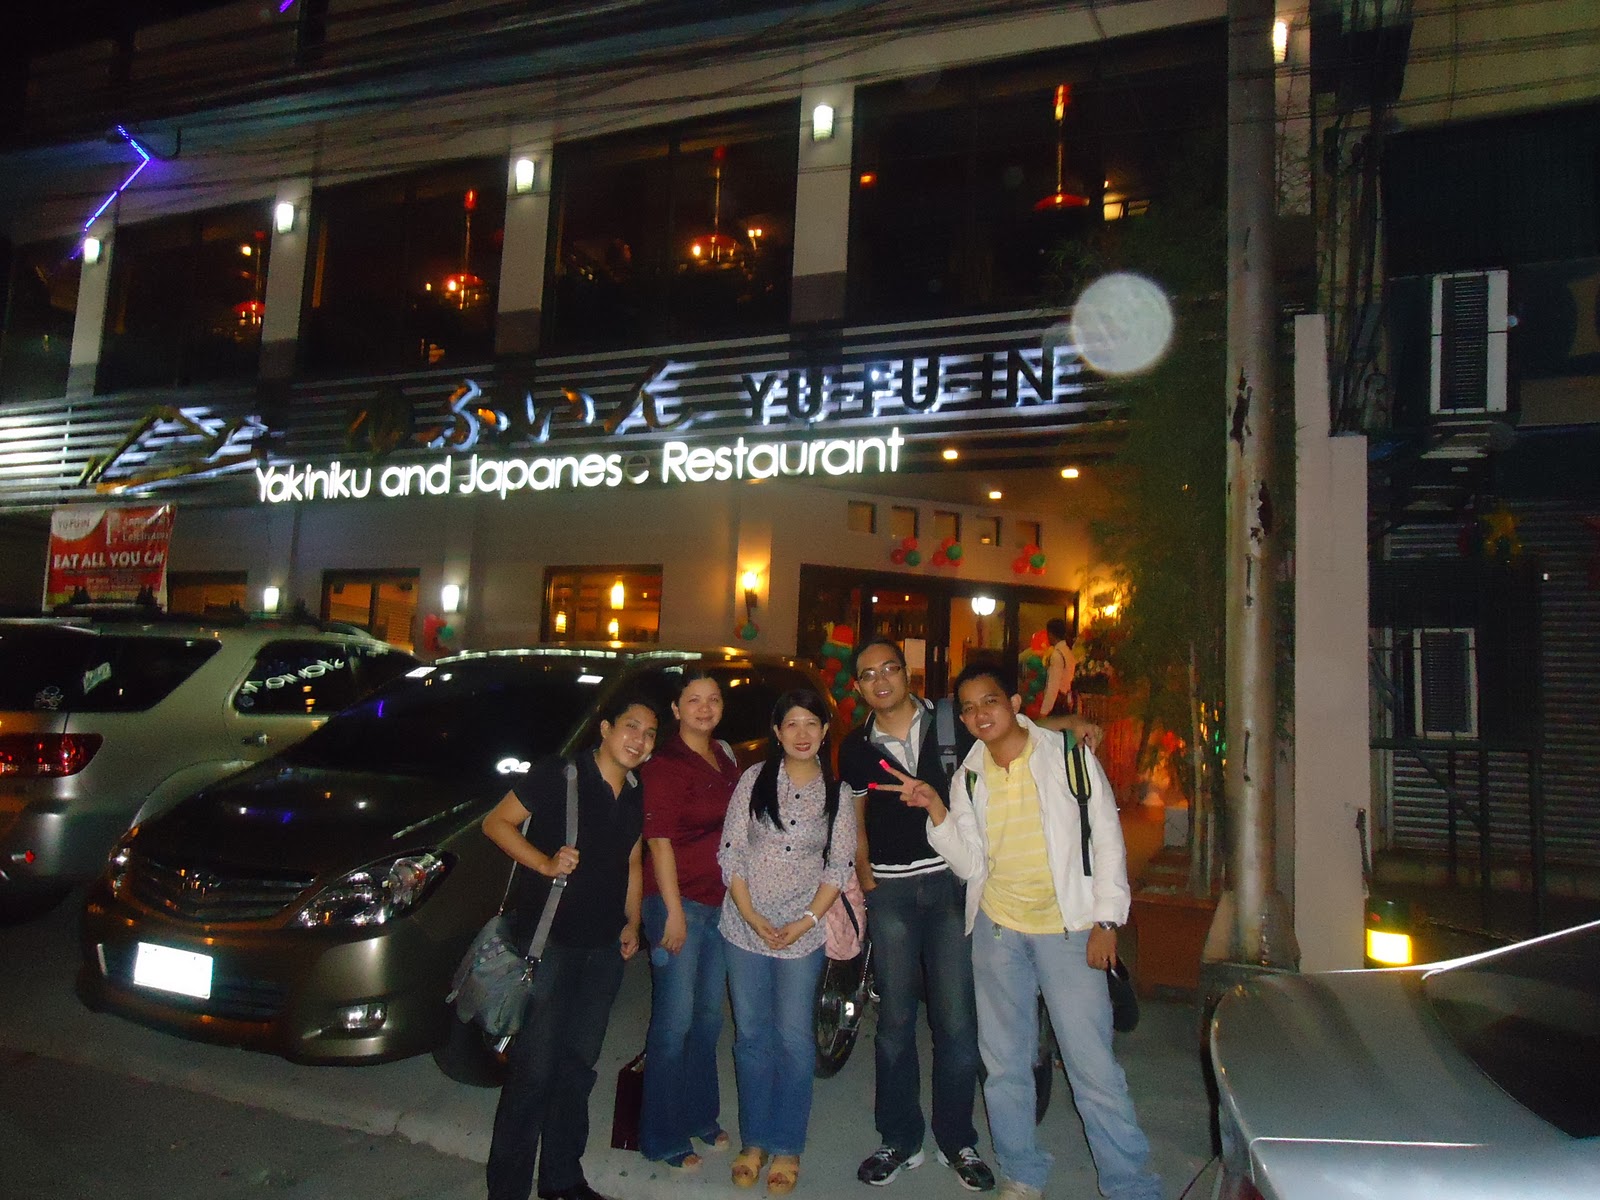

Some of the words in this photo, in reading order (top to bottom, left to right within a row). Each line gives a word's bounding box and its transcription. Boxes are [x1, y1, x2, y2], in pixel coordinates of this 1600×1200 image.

[255, 461, 372, 503] Yakiniku
[380, 454, 452, 498] and
[459, 453, 650, 500] Japanese
[661, 427, 905, 483] Restaurant
[54, 553, 79, 569] EAT
[81, 552, 107, 568] ALL
[109, 550, 140, 567] YOU
